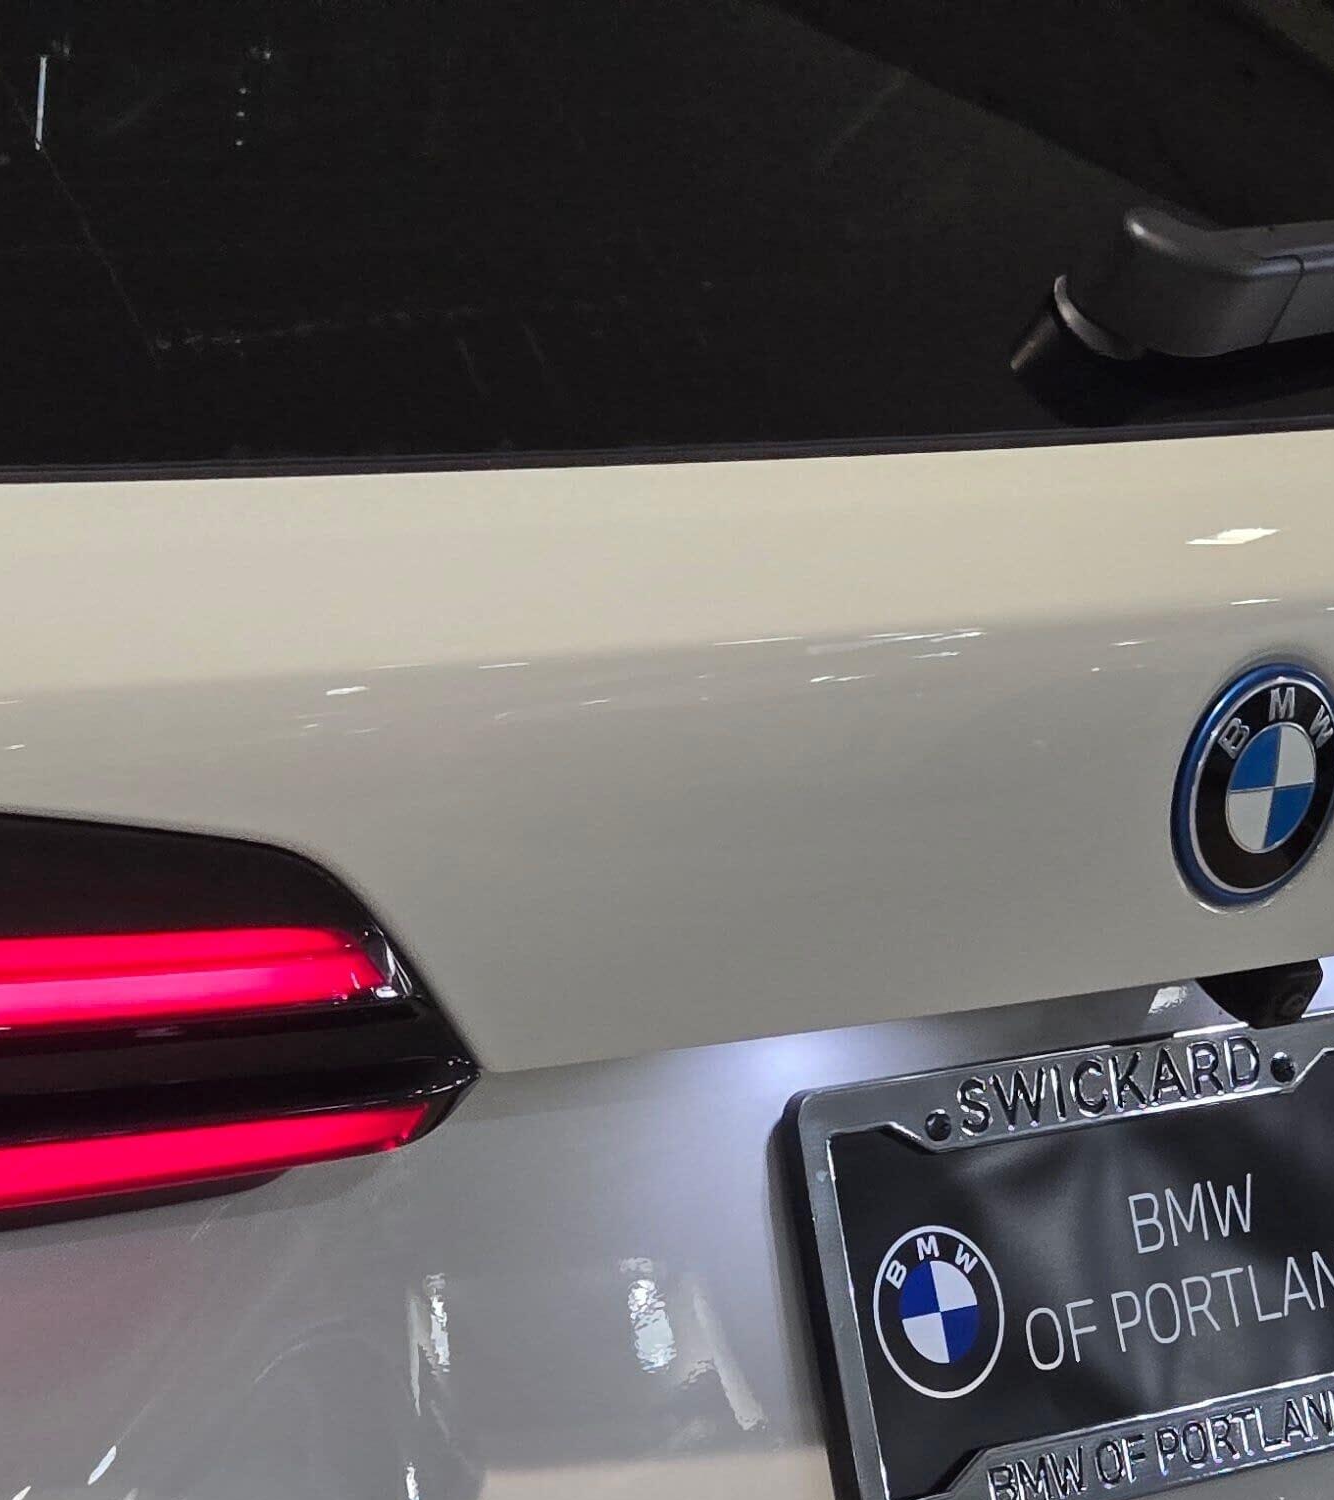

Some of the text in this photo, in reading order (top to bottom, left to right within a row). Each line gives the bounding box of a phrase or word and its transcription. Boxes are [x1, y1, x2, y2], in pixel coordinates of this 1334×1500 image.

[1218, 686, 1334, 759] BMW
[955, 1035, 1261, 1139] SWICKARD
[1127, 1173, 1253, 1255] BMW
[885, 1235, 978, 1291] BMW
[1024, 1298, 1099, 1372] OF
[1094, 1436, 1147, 1487] OF
